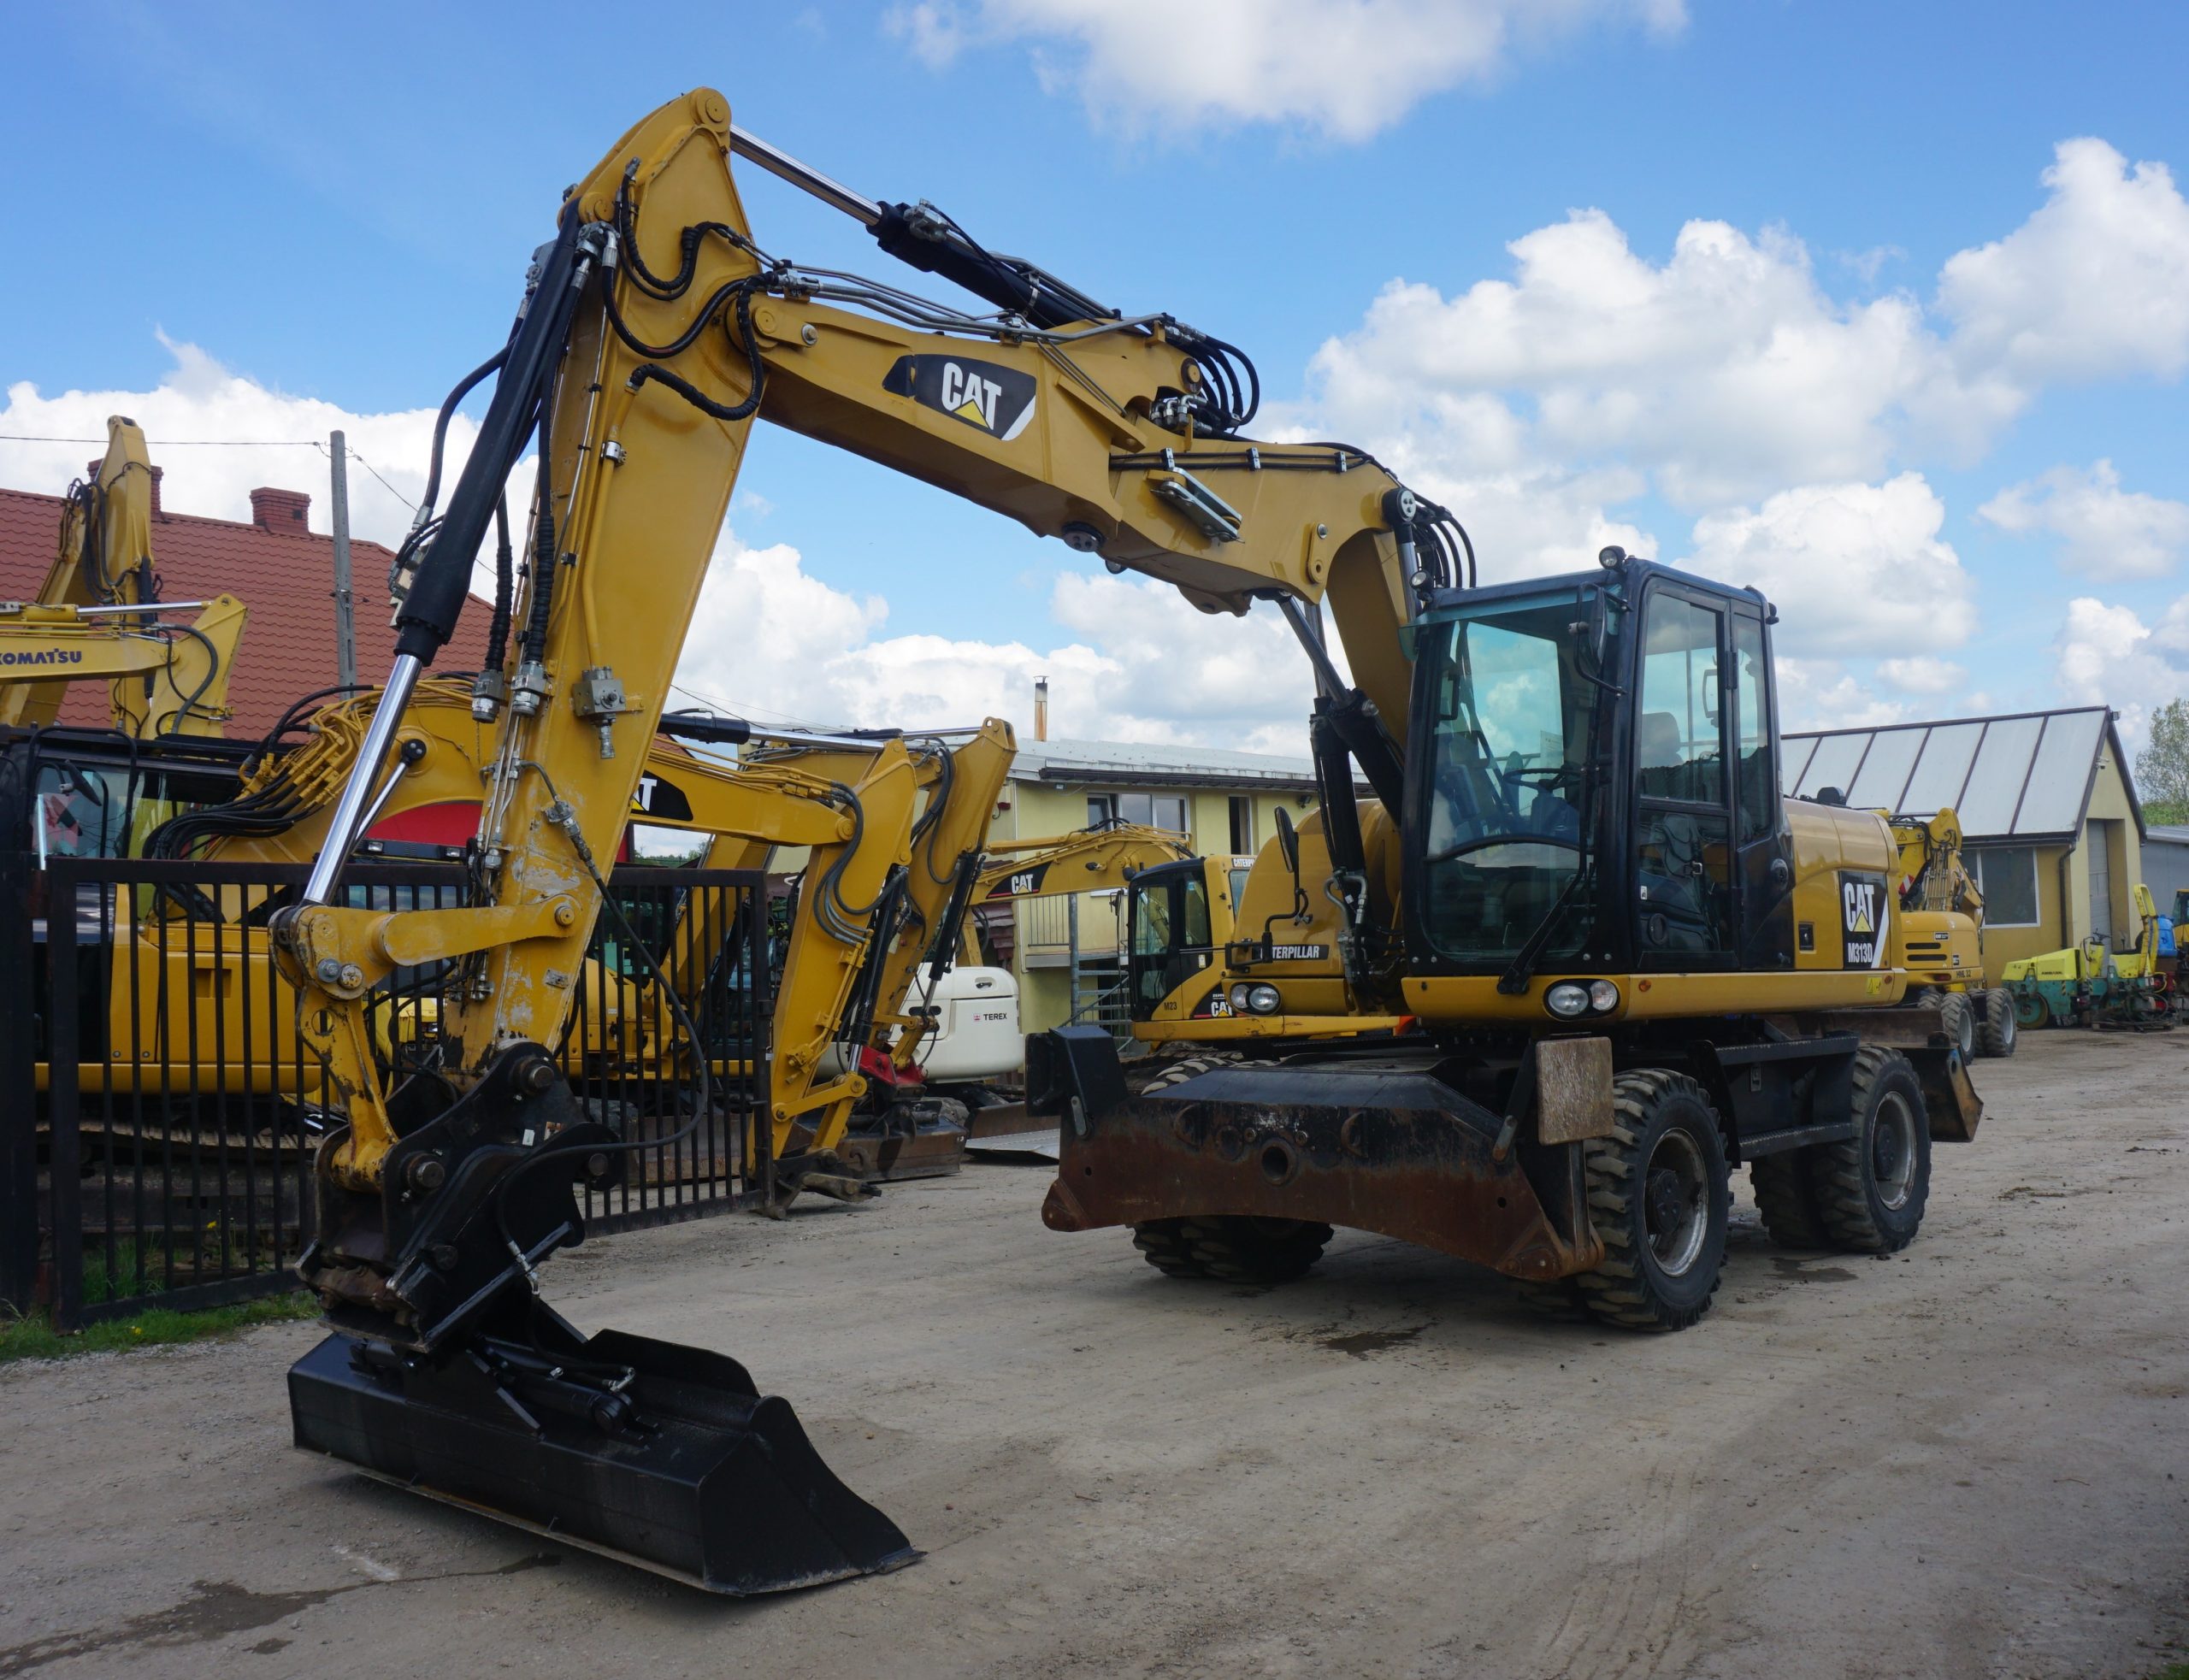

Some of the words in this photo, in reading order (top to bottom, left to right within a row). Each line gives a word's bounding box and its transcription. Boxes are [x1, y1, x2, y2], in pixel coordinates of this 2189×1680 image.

[941, 362, 1002, 430] CAT
[0, 648, 82, 665] OMATSU
[1012, 874, 1034, 894] CAT
[1844, 882, 1874, 932] CAT
[1260, 946, 1320, 959] TERPILLAR
[1848, 942, 1873, 963] M313D
[1164, 1001, 1177, 1011] M23
[983, 1012, 1007, 1021] TEREX
